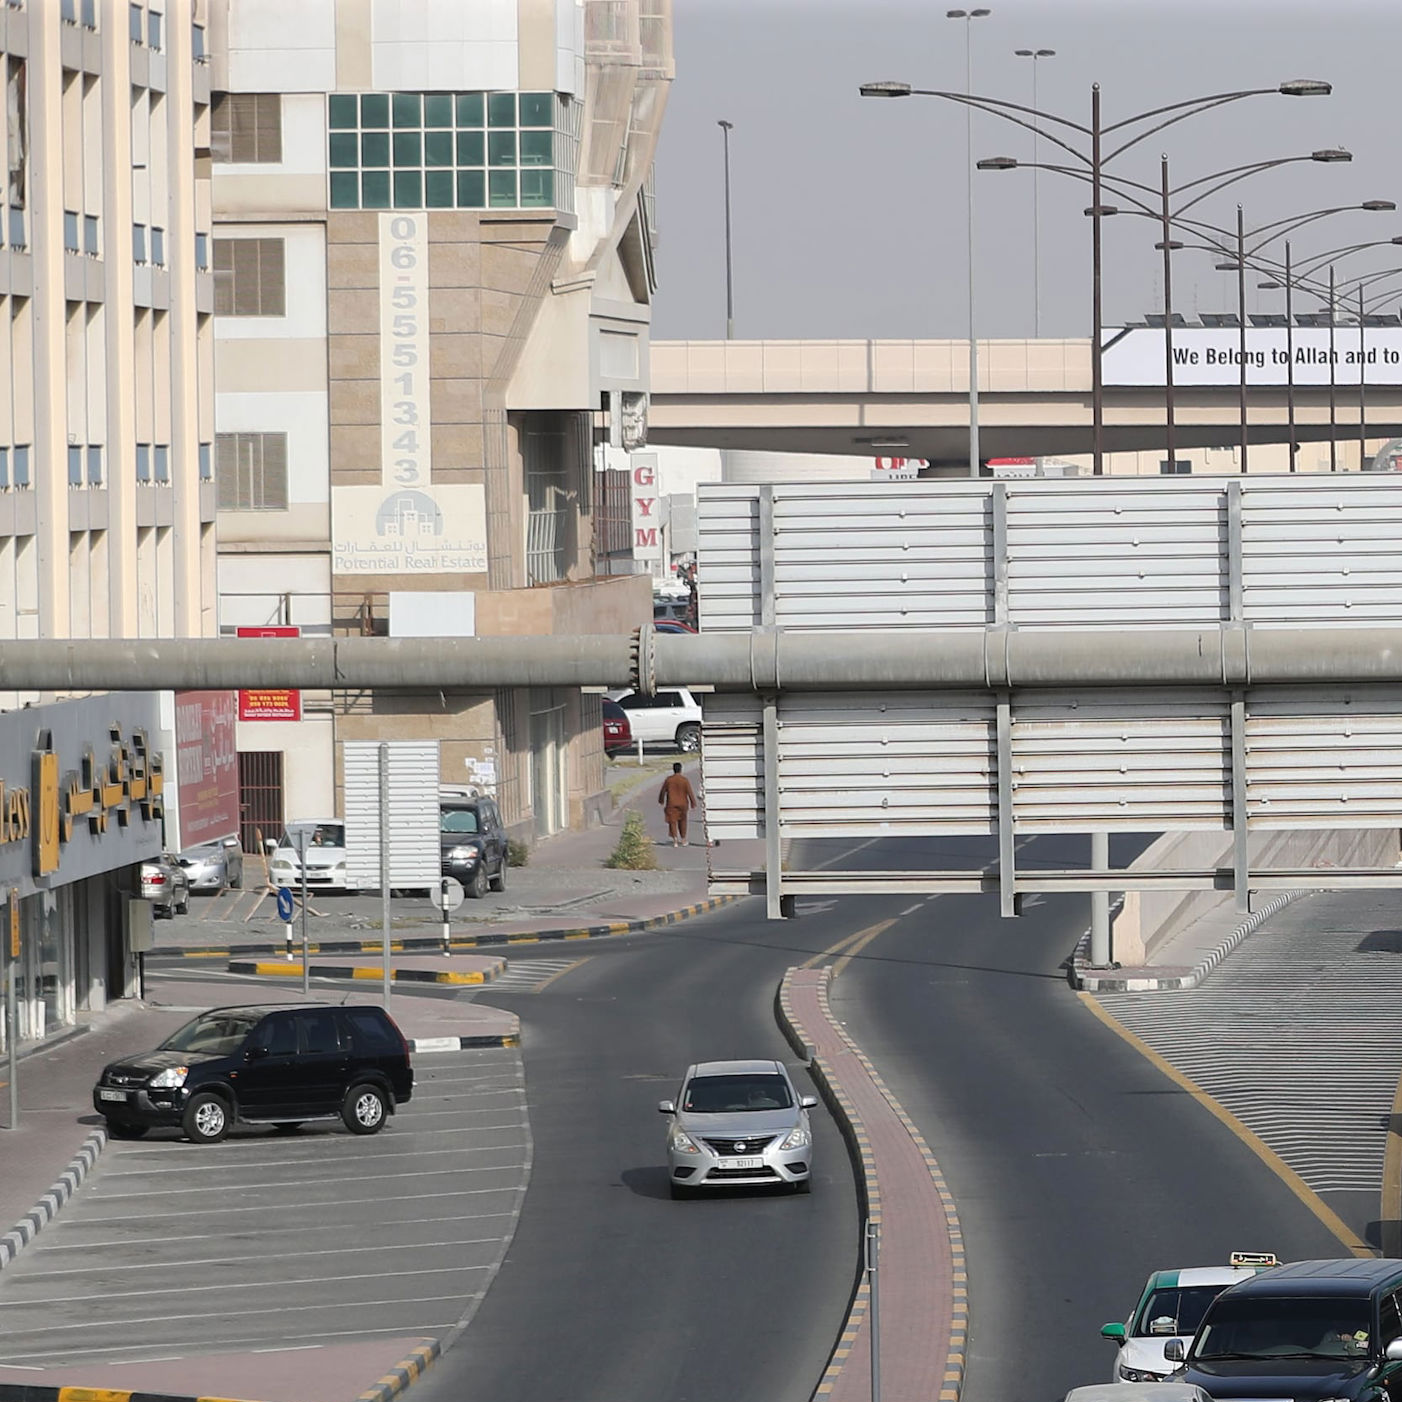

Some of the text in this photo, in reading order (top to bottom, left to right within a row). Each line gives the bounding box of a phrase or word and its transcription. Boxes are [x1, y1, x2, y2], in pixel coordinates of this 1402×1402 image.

[1173, 347, 1199, 365] We
[1206, 347, 1265, 368] Belong
[1271, 349, 1290, 365] to
[1295, 347, 1339, 365] Allah
[1345, 346, 1376, 365] and
[1383, 348, 1400, 364] to
[633, 466, 658, 548] GYM
[334, 556, 400, 570] Potential
[441, 554, 486, 569] Estate
